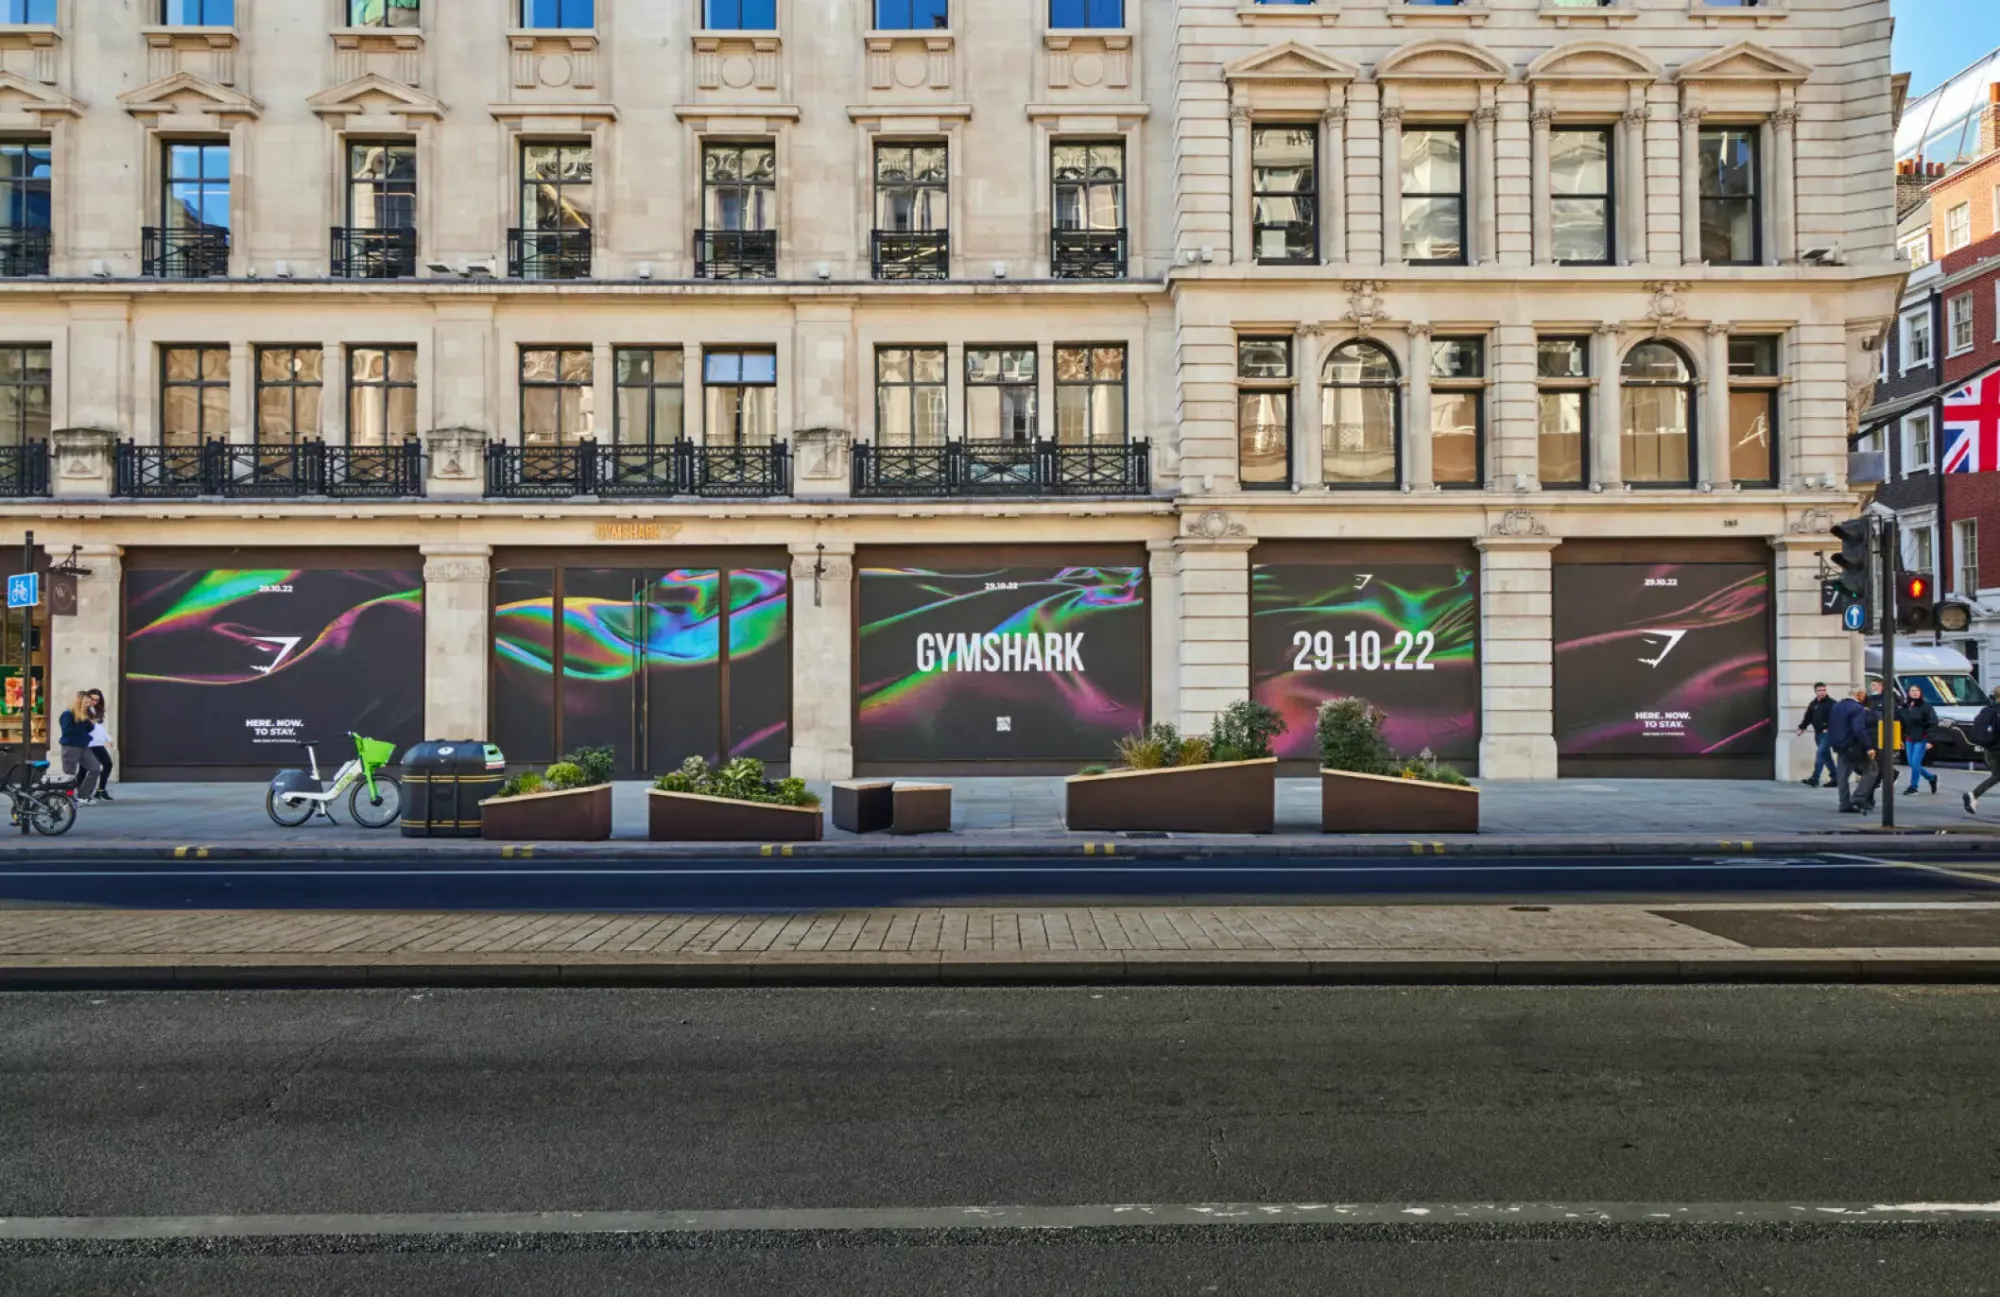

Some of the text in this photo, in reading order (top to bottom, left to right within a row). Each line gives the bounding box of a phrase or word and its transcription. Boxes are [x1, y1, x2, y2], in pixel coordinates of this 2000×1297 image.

[985, 582, 1018, 590] 29.10.22
[1644, 578, 1678, 587] 29.10.22
[916, 632, 1085, 672] GYMSHARK
[1293, 630, 1435, 671] 29.10.22
[1635, 712, 1692, 720] HERE. NOW.
[245, 719, 304, 727] HERE. NOW.
[1644, 720, 1684, 728] TO STAY.
[254, 728, 296, 736] TO STAY.
